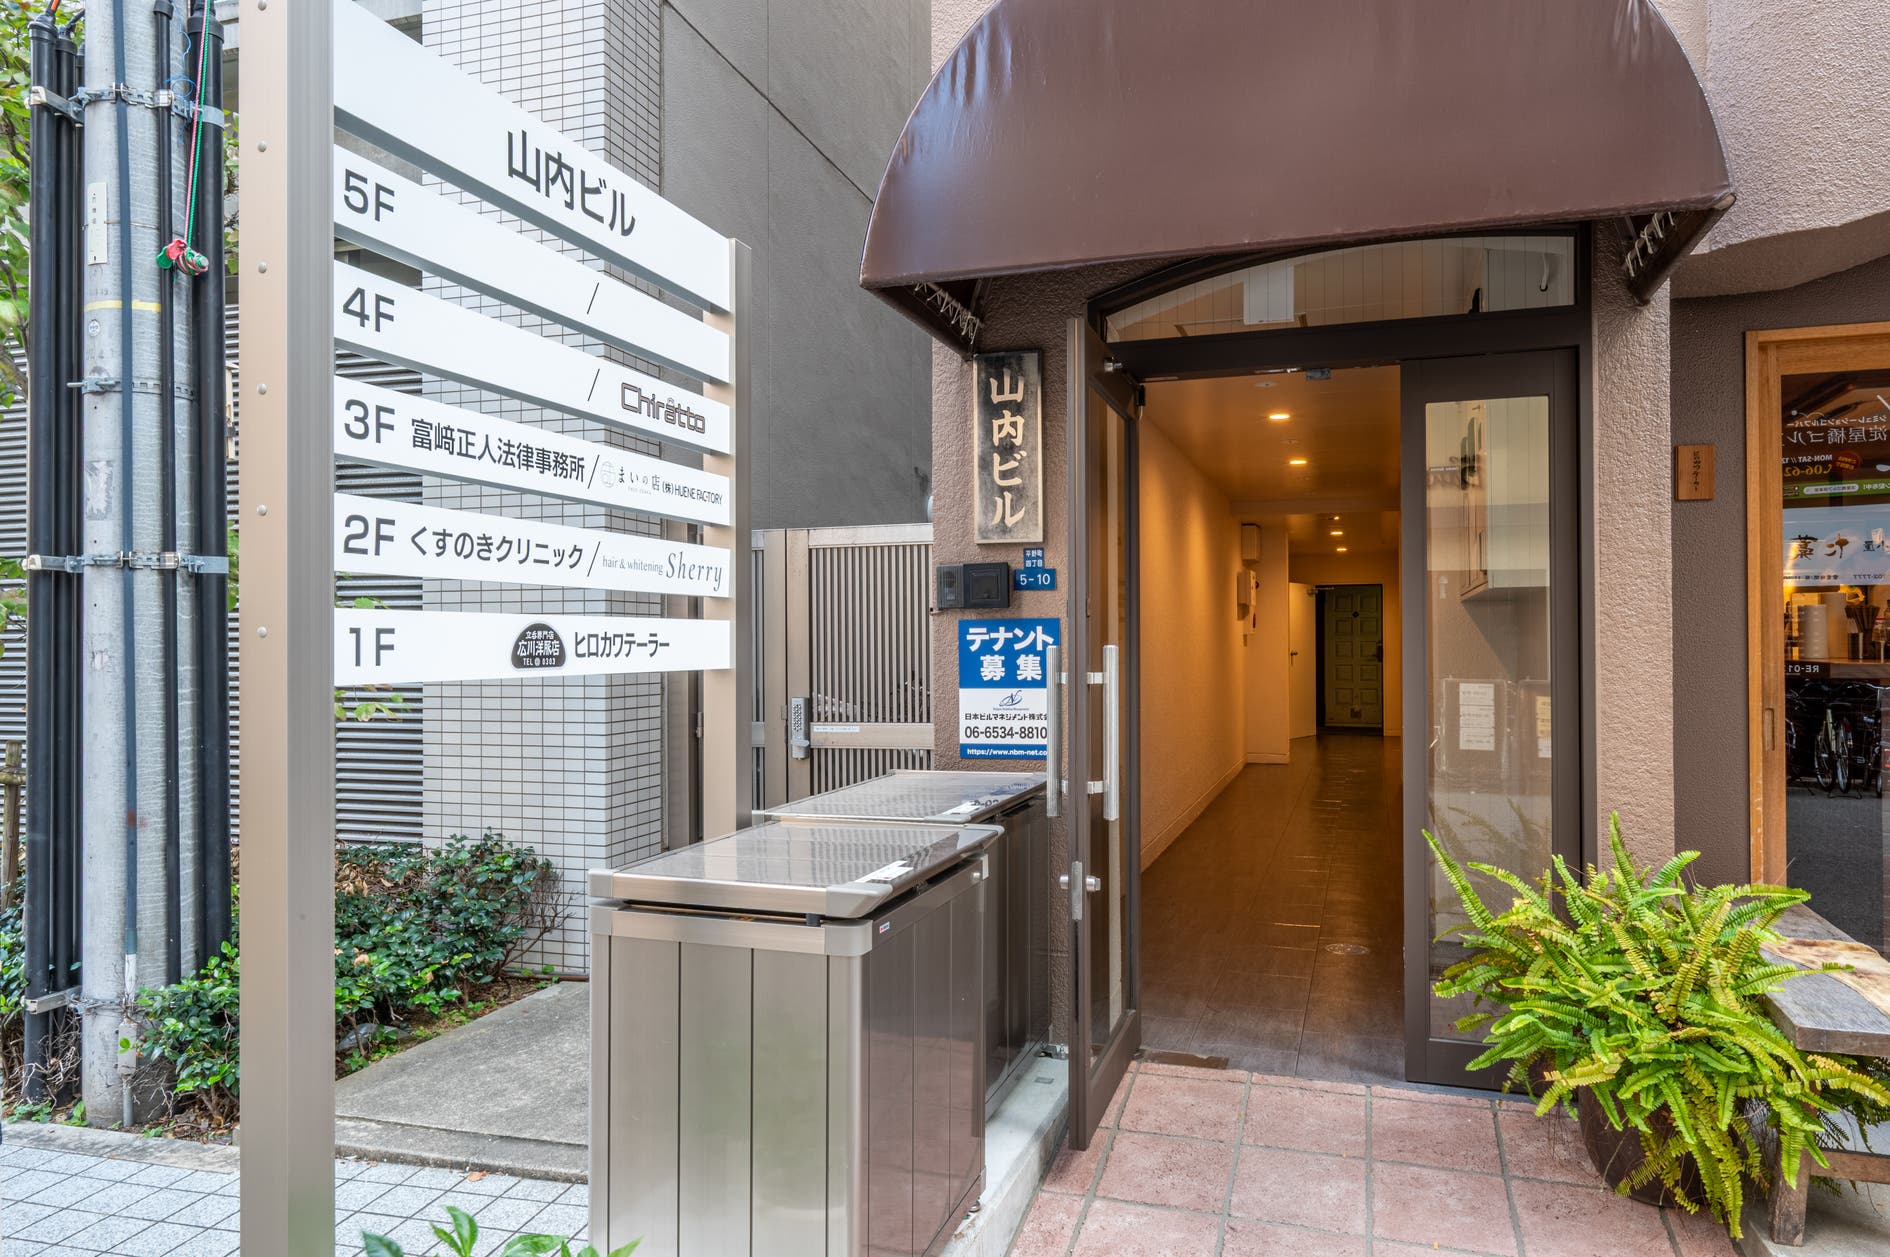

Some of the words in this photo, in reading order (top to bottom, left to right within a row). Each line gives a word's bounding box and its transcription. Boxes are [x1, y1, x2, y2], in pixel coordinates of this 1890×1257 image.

[343, 168, 395, 222] 5F
[507, 129, 636, 238] 山内ビル
[342, 287, 395, 333] 4F
[344, 399, 395, 443] 3F
[990, 368, 1027, 527] 山内ビル
[343, 514, 395, 557] 2F
[410, 526, 584, 570] くすのきクリニック
[602, 555, 618, 569] hair
[627, 559, 663, 575] whitening
[666, 551, 722, 592] Sherry
[1020, 573, 1051, 585] 5-10
[349, 627, 395, 667] 1F
[575, 631, 670, 658] ヒロカワテーラー
[966, 626, 1054, 652] テナント
[523, 658, 533, 666] TEL
[965, 726, 1047, 739] 06-6534-8810
